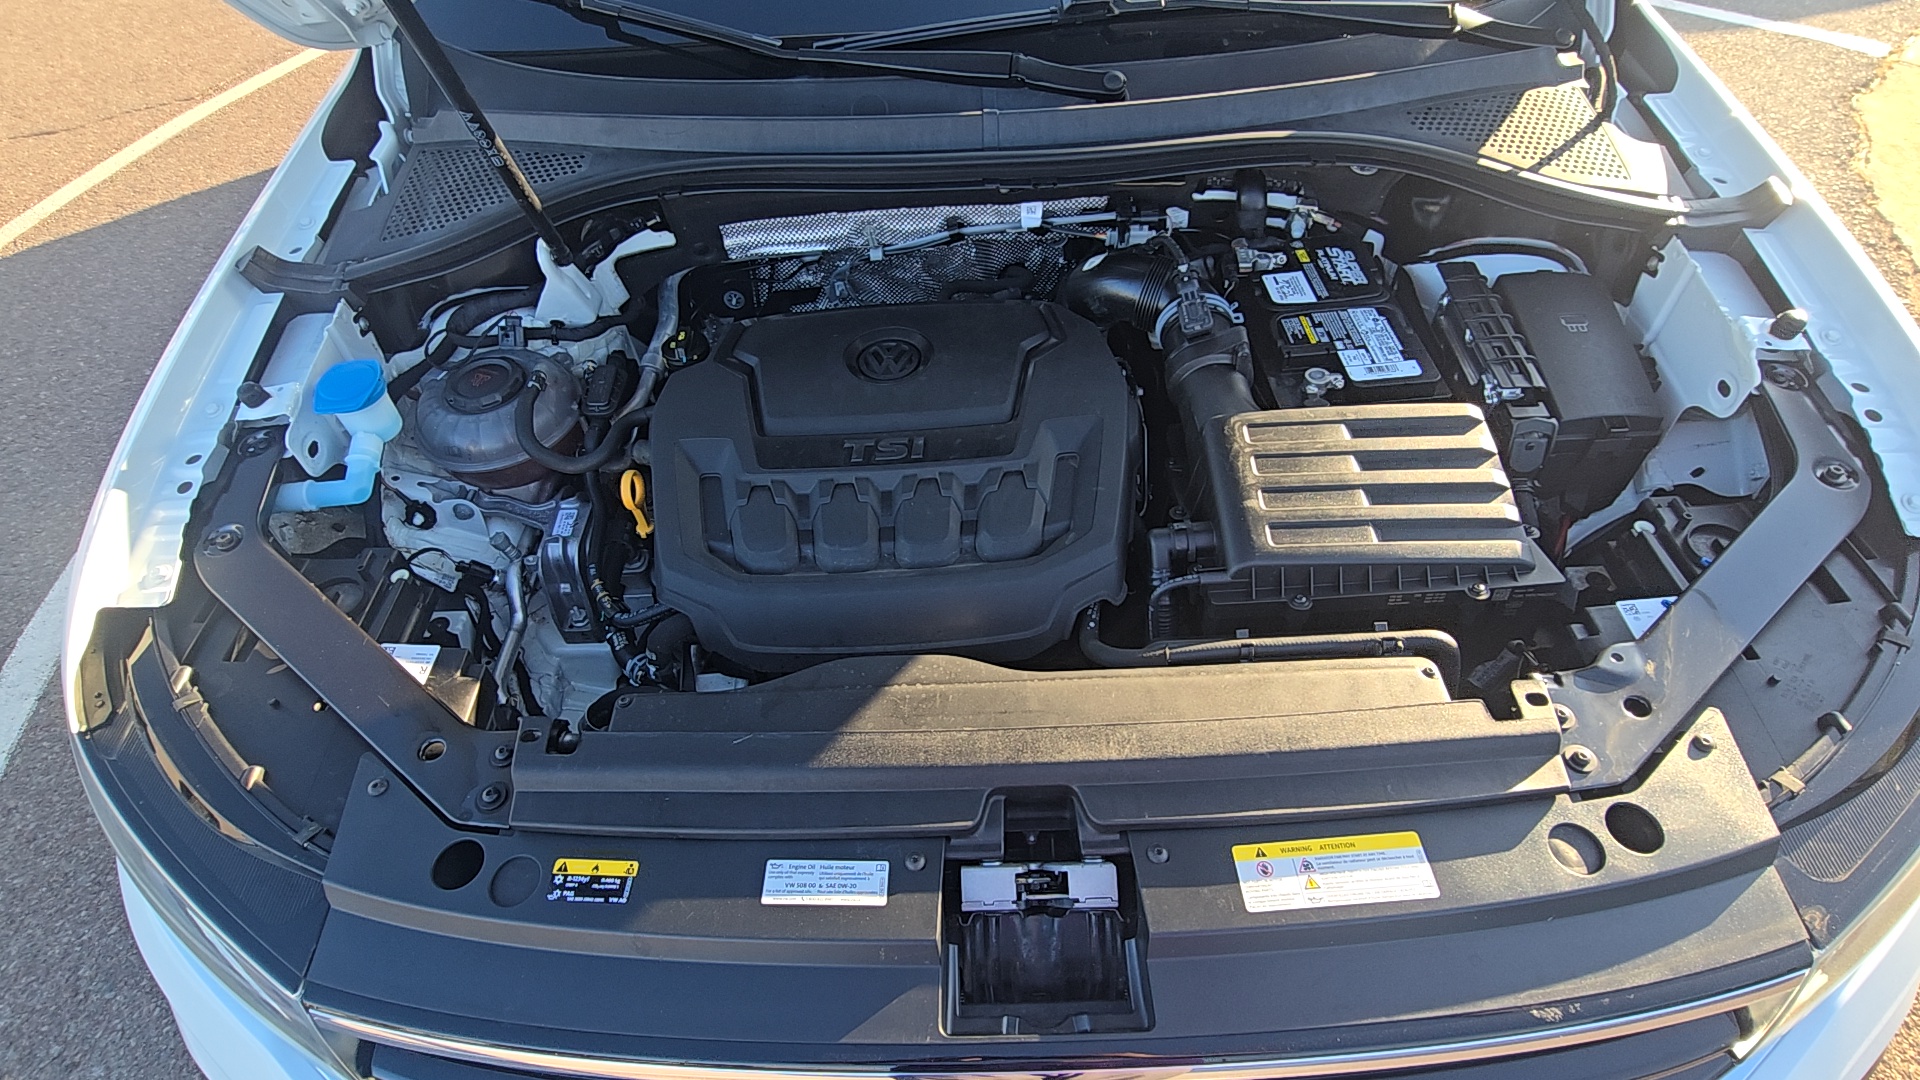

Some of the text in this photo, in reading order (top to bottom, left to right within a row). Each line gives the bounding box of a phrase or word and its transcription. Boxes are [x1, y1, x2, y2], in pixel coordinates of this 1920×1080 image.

[1315, 249, 1339, 281] PLATINUM
[1325, 246, 1352, 286] START
[1342, 250, 1368, 285] SUPER
[843, 435, 925, 462] TSI
[1279, 841, 1356, 854] WARNING ATTENTION
